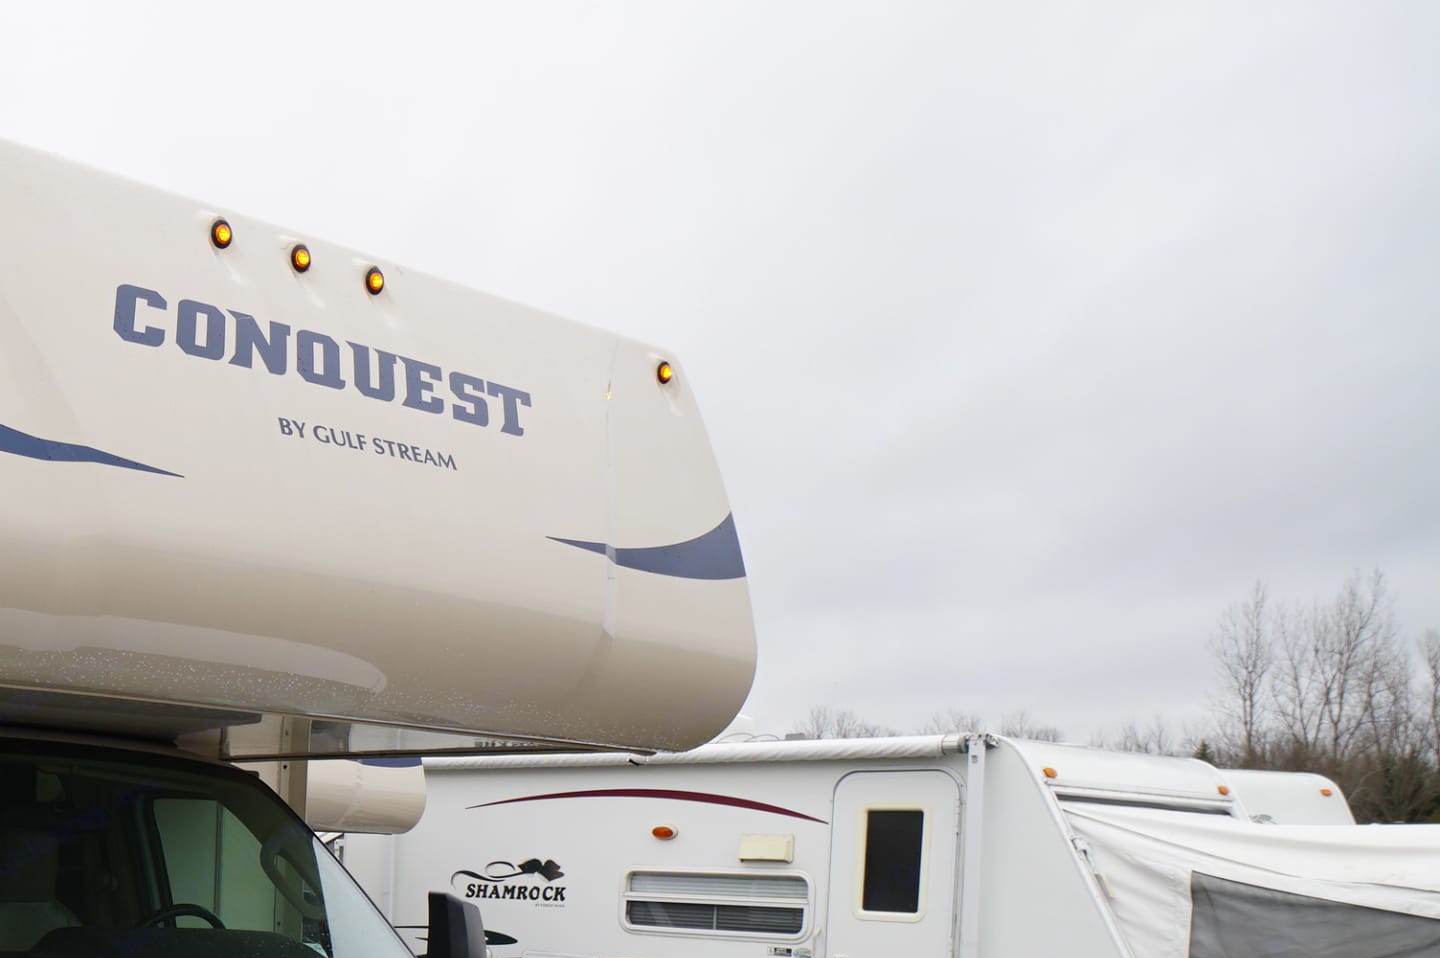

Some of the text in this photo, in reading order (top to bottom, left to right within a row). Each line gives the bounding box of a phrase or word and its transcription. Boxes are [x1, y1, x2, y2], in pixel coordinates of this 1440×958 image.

[113, 283, 533, 437] CONQUEST
[278, 417, 458, 471] BY GULF STREAM
[465, 883, 566, 901] SHAMROCK
